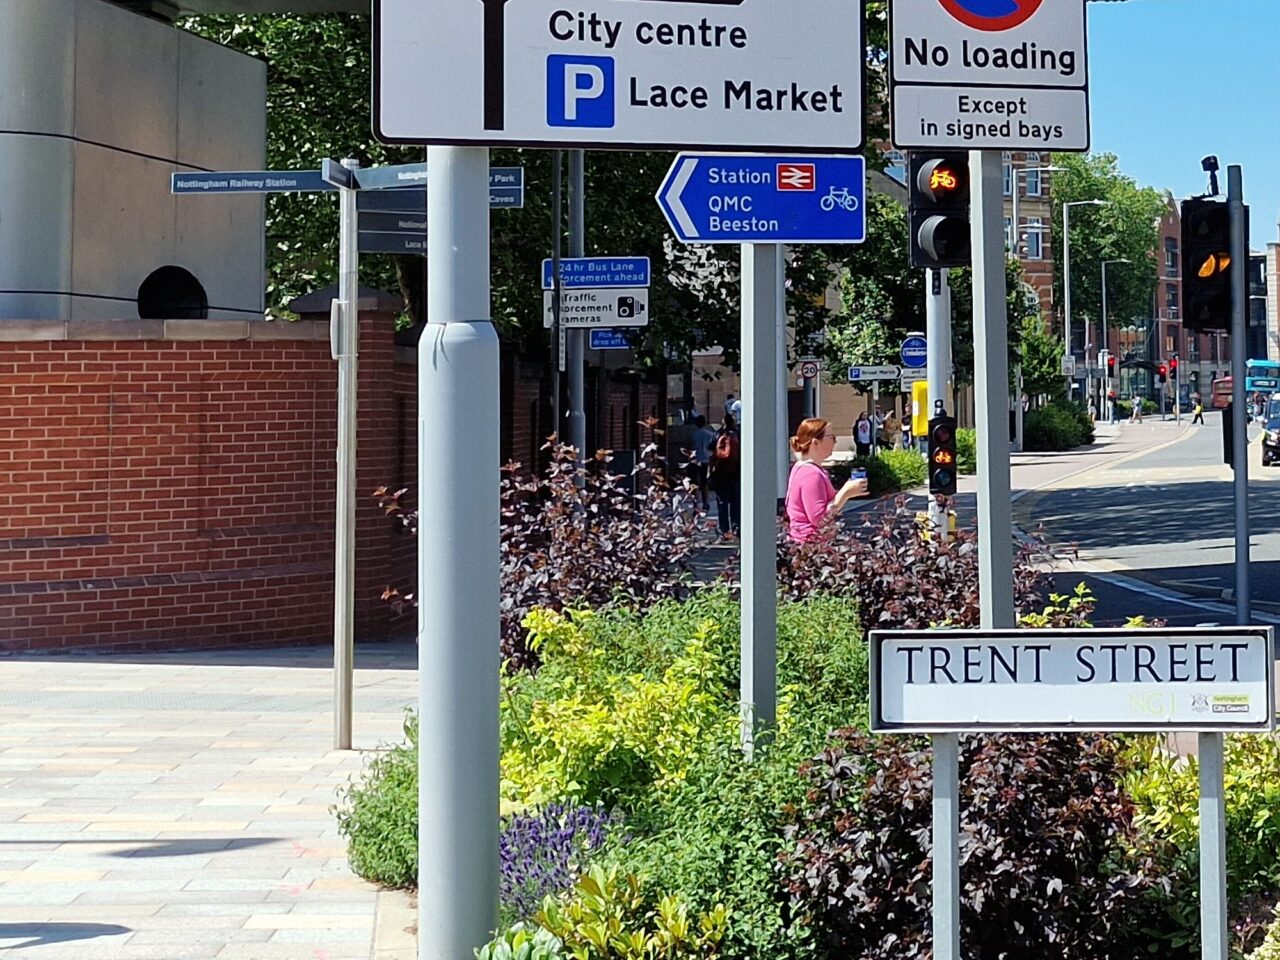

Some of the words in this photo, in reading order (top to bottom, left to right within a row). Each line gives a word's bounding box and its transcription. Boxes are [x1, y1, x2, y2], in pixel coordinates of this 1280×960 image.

[549, 10, 622, 48] City
[636, 18, 748, 48] centre
[905, 37, 949, 68] No
[962, 40, 1075, 75] loading
[629, 76, 708, 108] Lace
[724, 80, 843, 113] Market
[958, 95, 1027, 115] Except
[920, 118, 938, 136] in
[946, 120, 1011, 139] signed
[1018, 121, 1063, 140] bays
[176, 180, 229, 189] Nottingham
[229, 179, 264, 188] Railway
[265, 179, 297, 187] Station
[494, 175, 515, 183] Park
[708, 168, 771, 184] Station
[708, 196, 753, 213] QMC
[709, 216, 779, 232] Beeston
[560, 264, 571, 272] 24
[574, 263, 584, 271] hr
[588, 263, 607, 271] Bus
[611, 262, 634, 271] Lane
[548, 273, 611, 282] eforcement
[614, 273, 645, 281] ahead
[564, 294, 597, 302] Traffic
[548, 304, 613, 312] eorcement
[562, 315, 602, 323] ameras
[803, 366, 815, 374] 20
[896, 644, 1052, 684] TRENT
[1075, 643, 1249, 683] STREET
